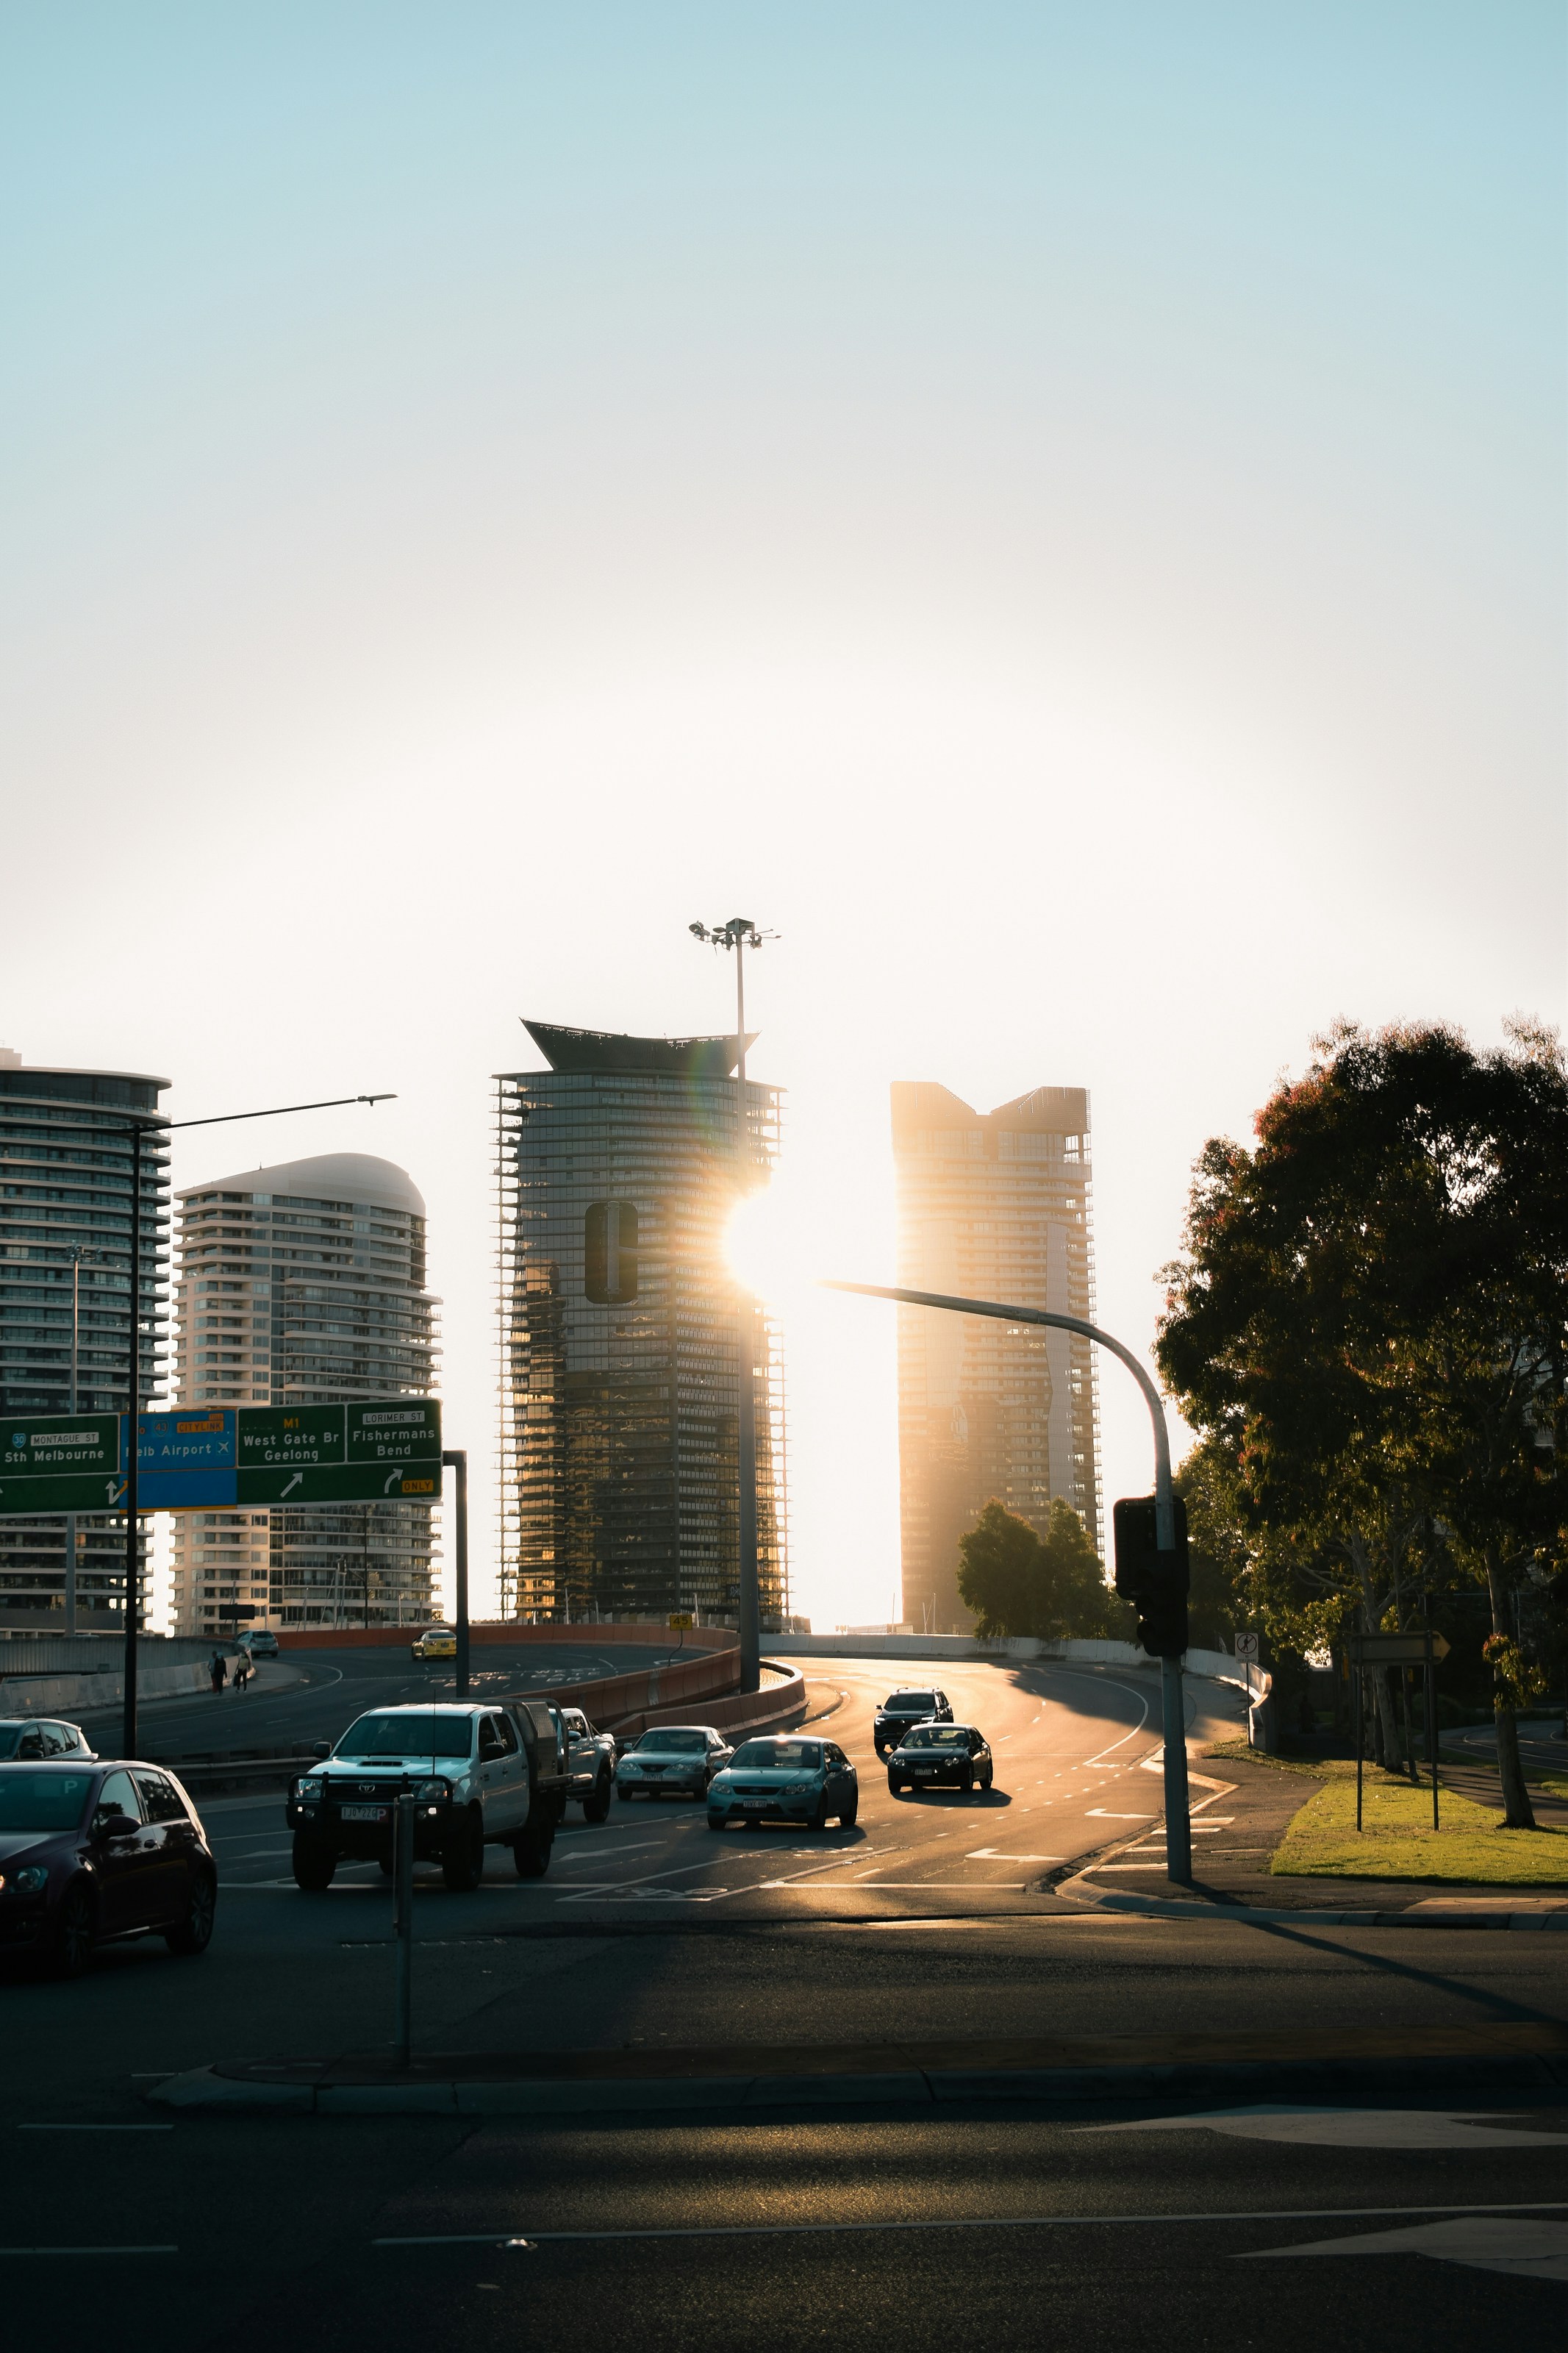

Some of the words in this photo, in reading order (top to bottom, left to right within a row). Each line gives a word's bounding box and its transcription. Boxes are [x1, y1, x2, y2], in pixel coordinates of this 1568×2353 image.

[284, 1418, 299, 1429] M1
[365, 1413, 405, 1423] LORIMER
[411, 1413, 422, 1421] ST
[155, 1423, 168, 1432] 43
[179, 1422, 221, 1432] CITYLINK
[15, 1435, 24, 1443] 30
[34, 1435, 80, 1444] MONTAGUE
[85, 1434, 96, 1442] ST
[244, 1435, 276, 1446] West
[284, 1433, 316, 1445] Gate
[323, 1432, 339, 1443] Br
[353, 1429, 435, 1441] Fishermans
[162, 1443, 211, 1457] Airport
[265, 1449, 318, 1462] Geelong
[377, 1444, 411, 1456] Bend
[4, 1452, 27, 1463] Sth
[35, 1450, 104, 1461] Melbourne
[404, 1481, 432, 1491] ONLY
[673, 1616, 688, 1625] 45
[65, 1780, 78, 1794] P
[376, 1808, 387, 1820] P
